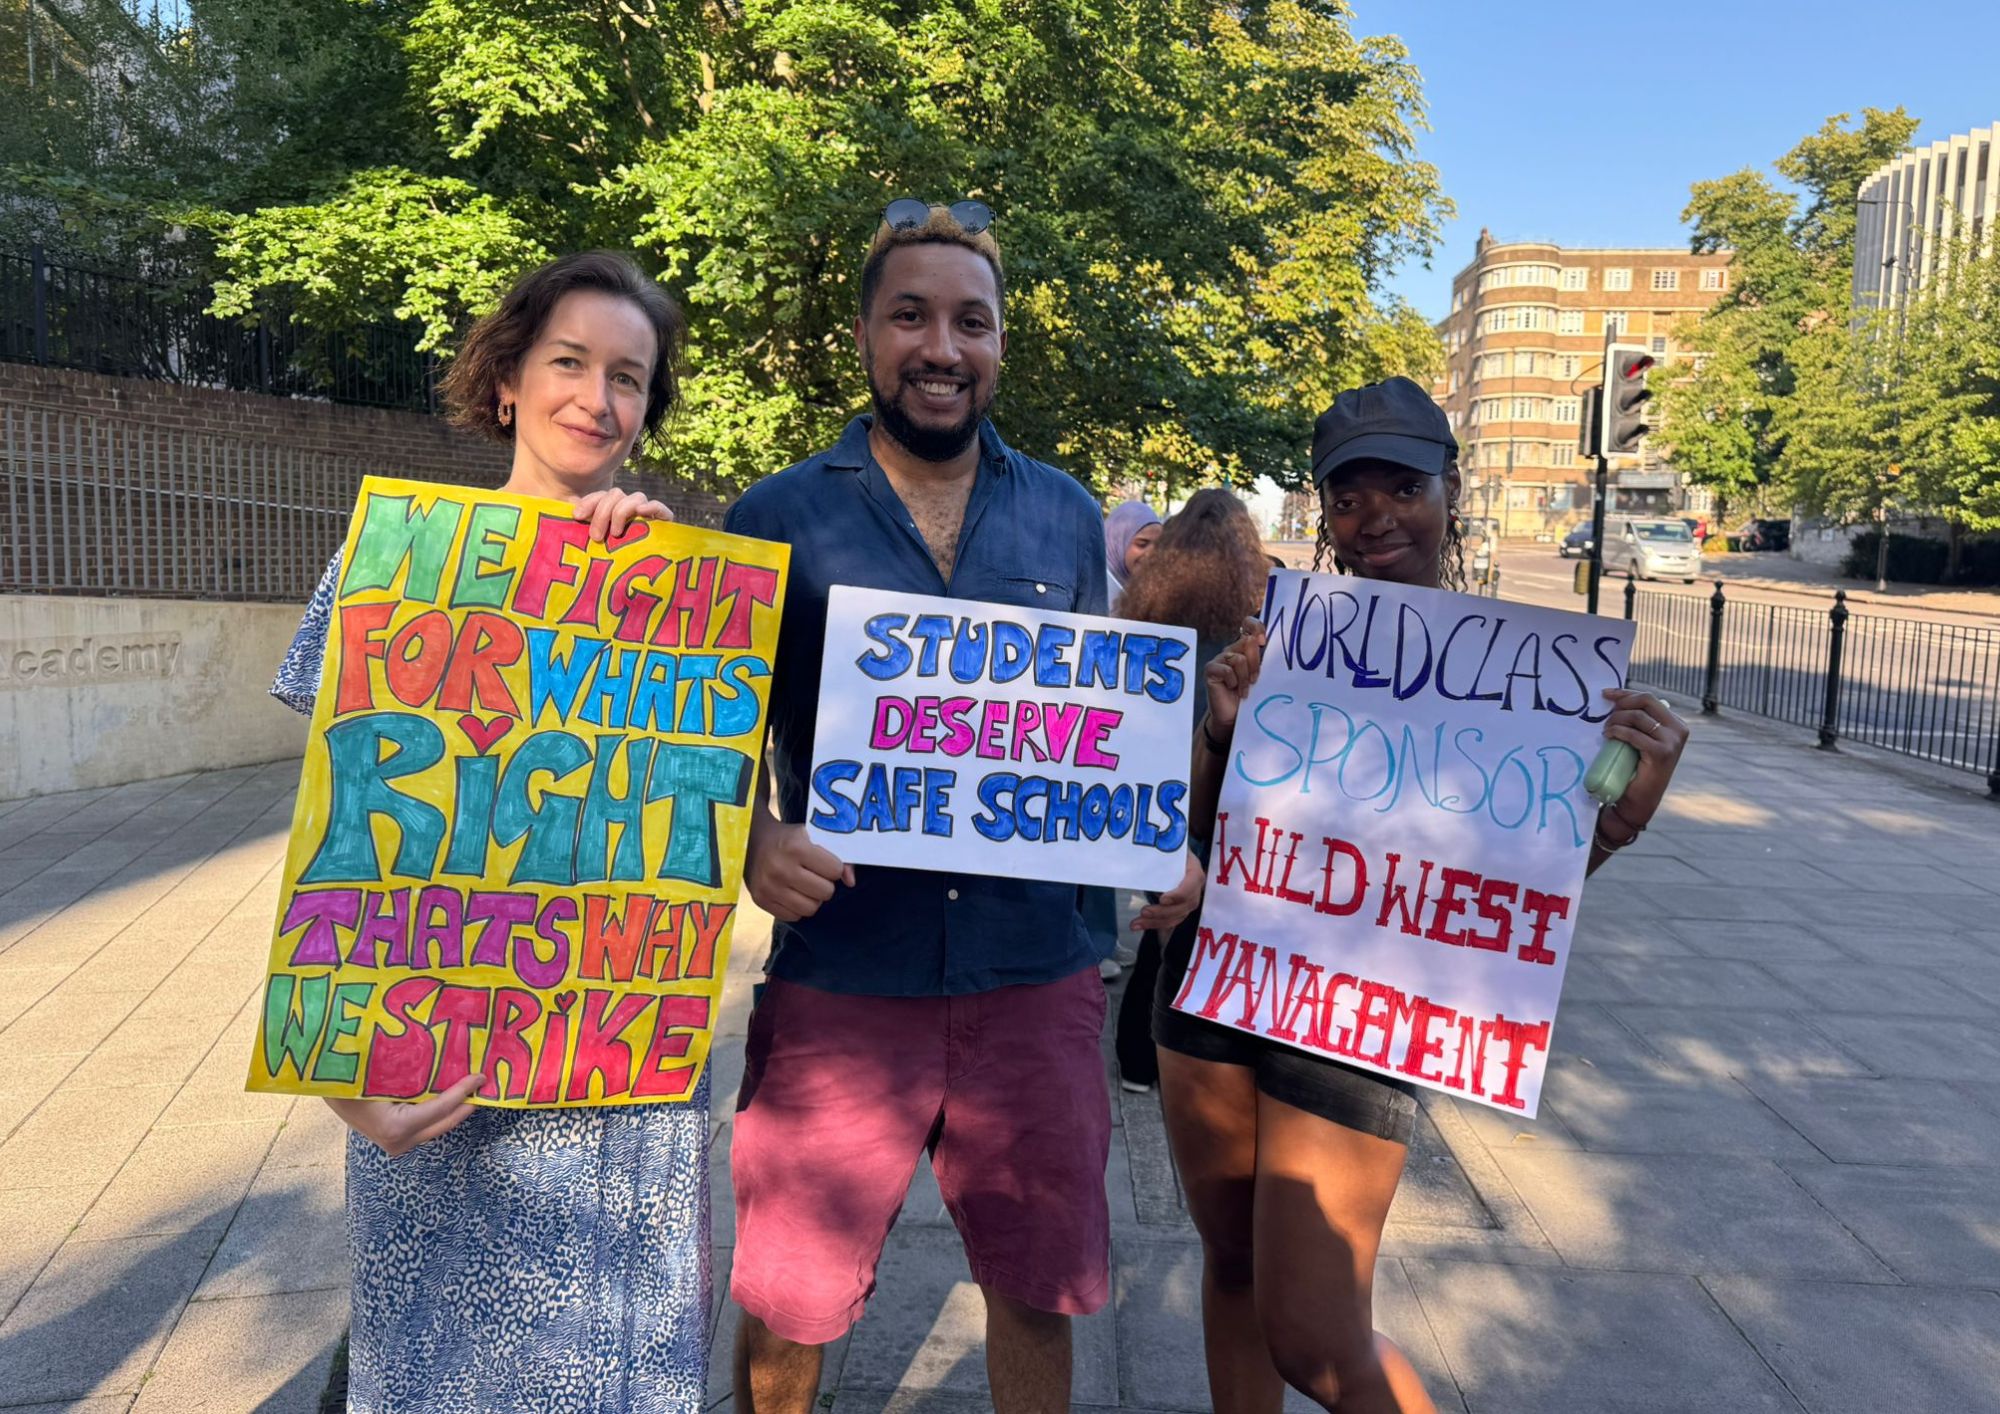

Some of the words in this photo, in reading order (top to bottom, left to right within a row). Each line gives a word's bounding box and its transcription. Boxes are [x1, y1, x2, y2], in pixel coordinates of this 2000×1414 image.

[340, 492, 521, 609] WE
[511, 514, 779, 649] FIGHT
[334, 600, 526, 720] FOR
[525, 627, 773, 737] WHATS
[855, 613, 1190, 703] STUDENTS
[297, 711, 755, 888] RIGHT
[869, 695, 1124, 771] DESERVE
[1235, 694, 1587, 848] SPONSOR
[809, 759, 957, 838] SAFE
[971, 772, 1188, 853] SCHOOLS
[279, 885, 579, 989] THATS
[578, 893, 737, 983] WHY
[1216, 812, 1369, 917] WILD
[1376, 853, 1572, 966] WEST
[264, 972, 377, 1084] WE
[363, 976, 711, 1104] STRIKE
[1173, 927, 1551, 1110] MANAGEMENT
